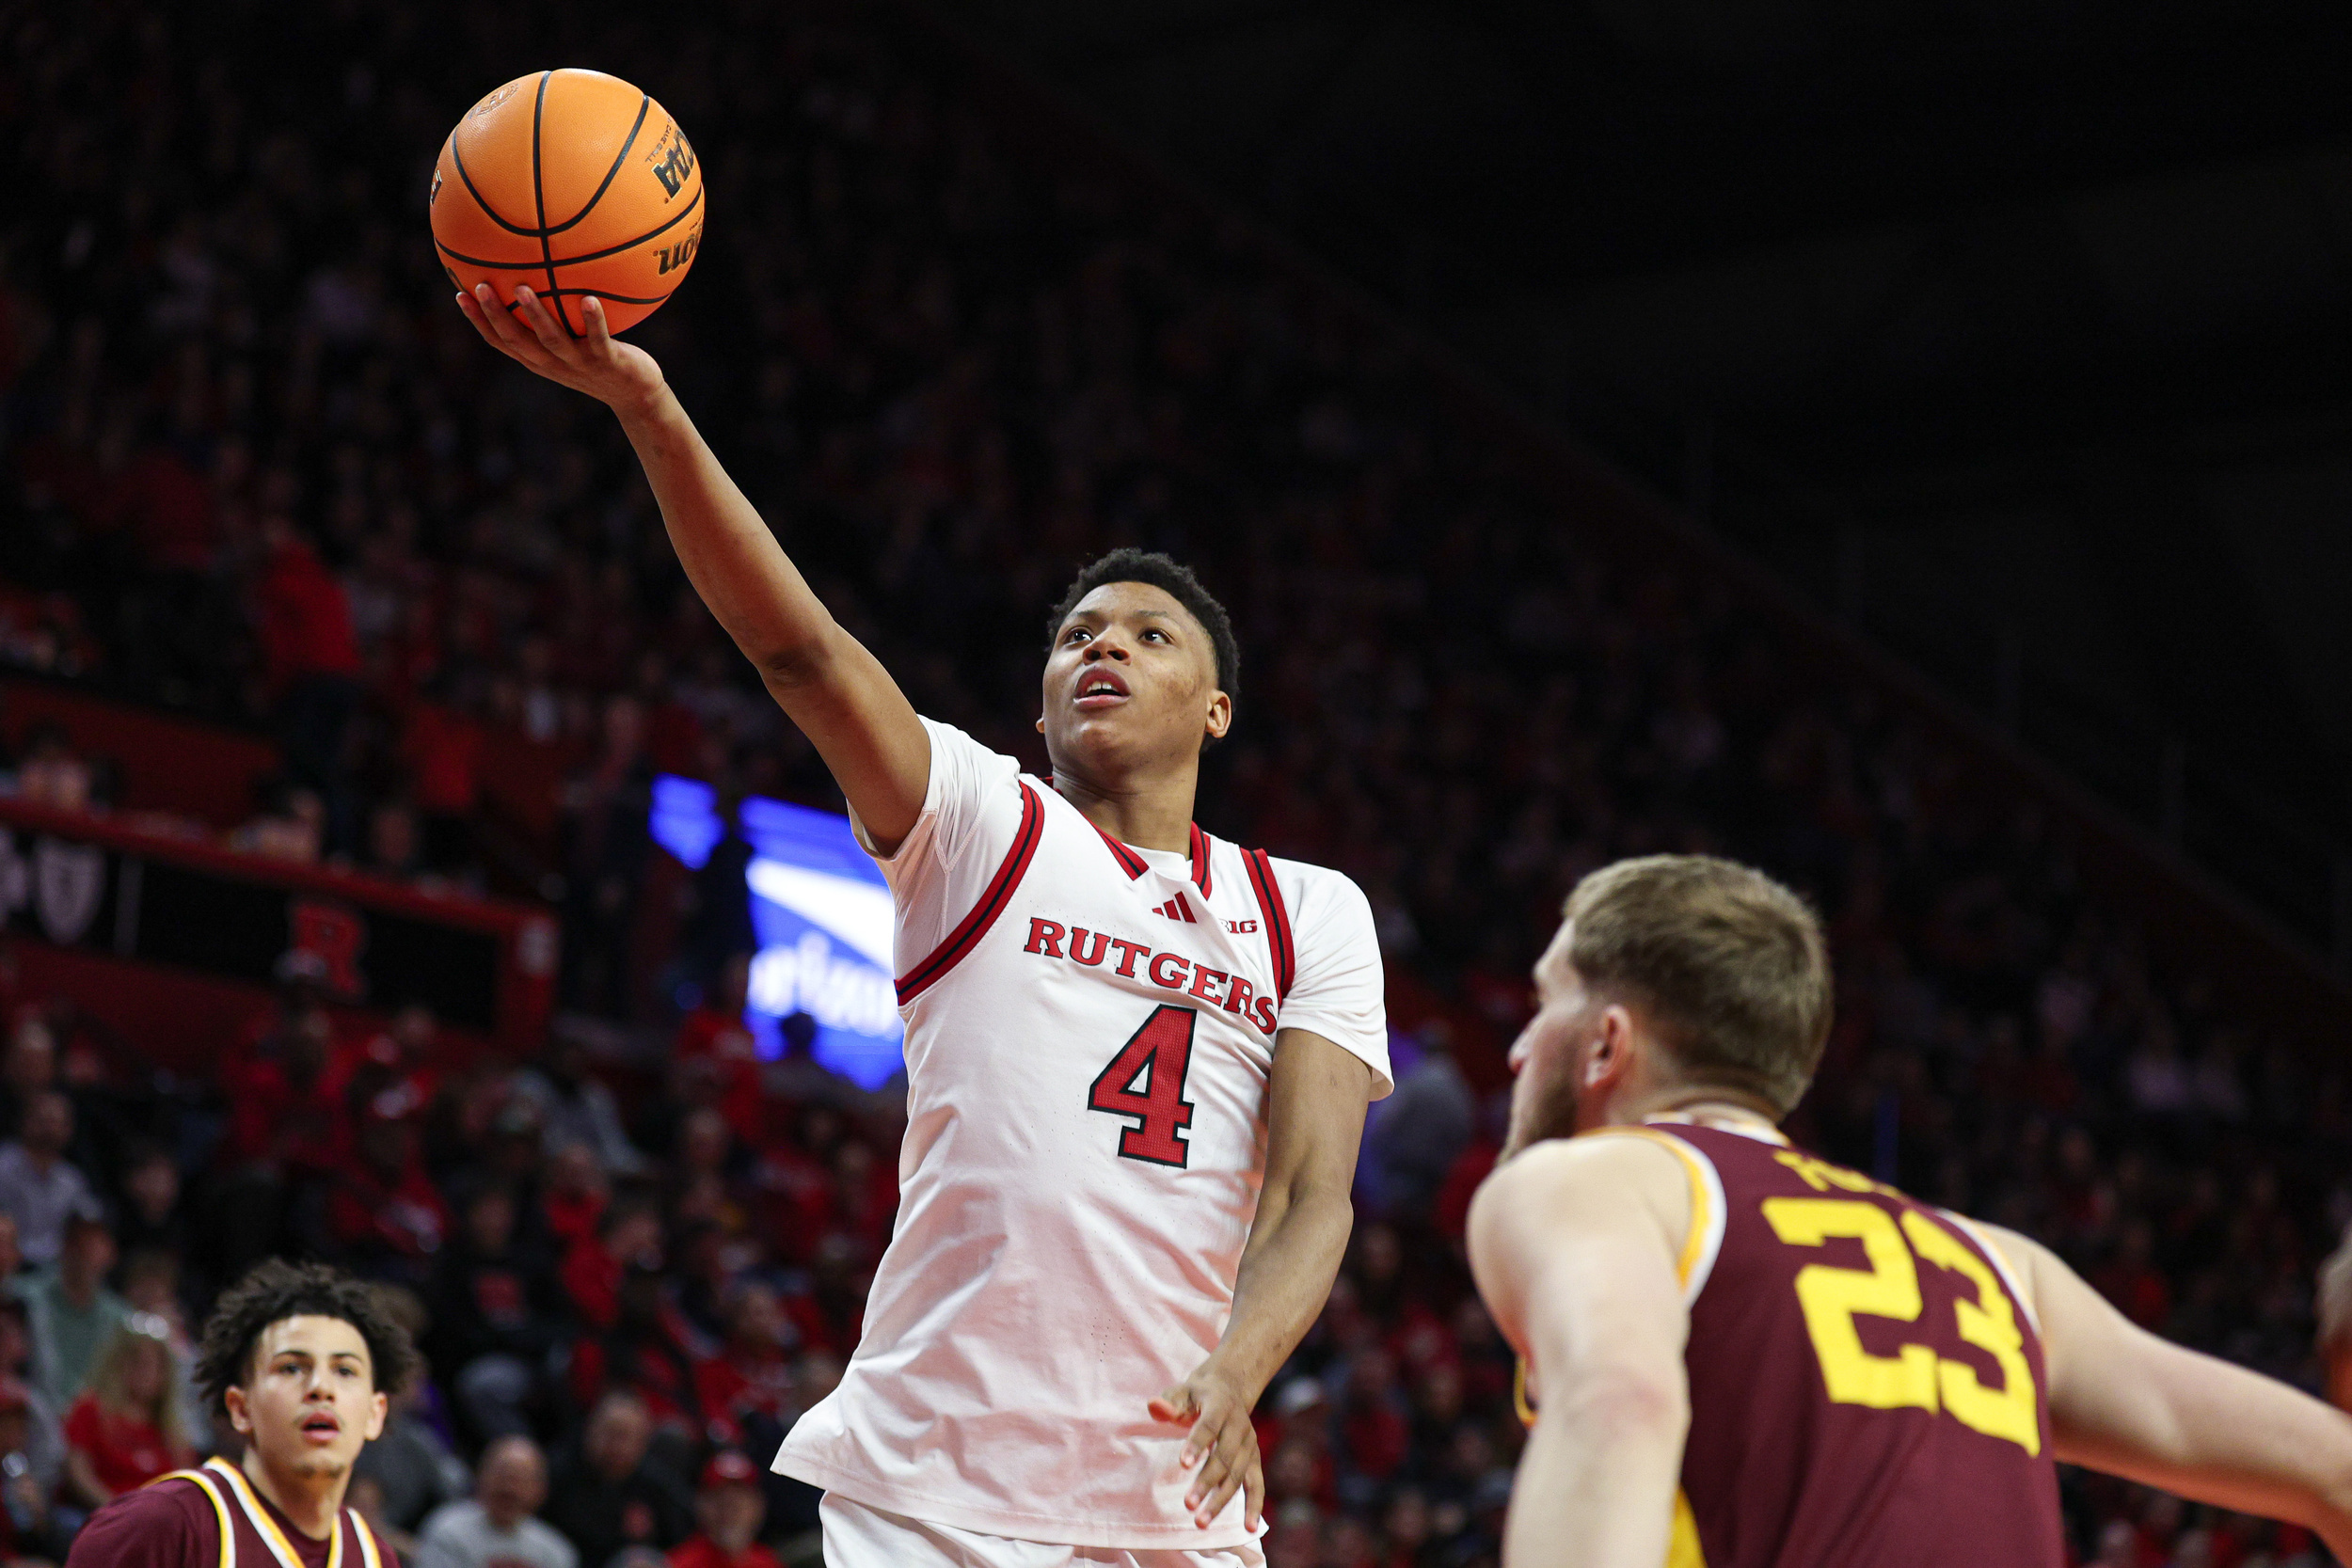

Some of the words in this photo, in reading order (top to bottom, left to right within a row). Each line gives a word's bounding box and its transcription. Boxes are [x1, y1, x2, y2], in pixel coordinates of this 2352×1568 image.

[652, 131, 694, 199] CAA
[1024, 917, 1277, 1035] RUTGERS
[1088, 1004, 1197, 1169] 4
[1761, 1197, 2041, 1458] 23
